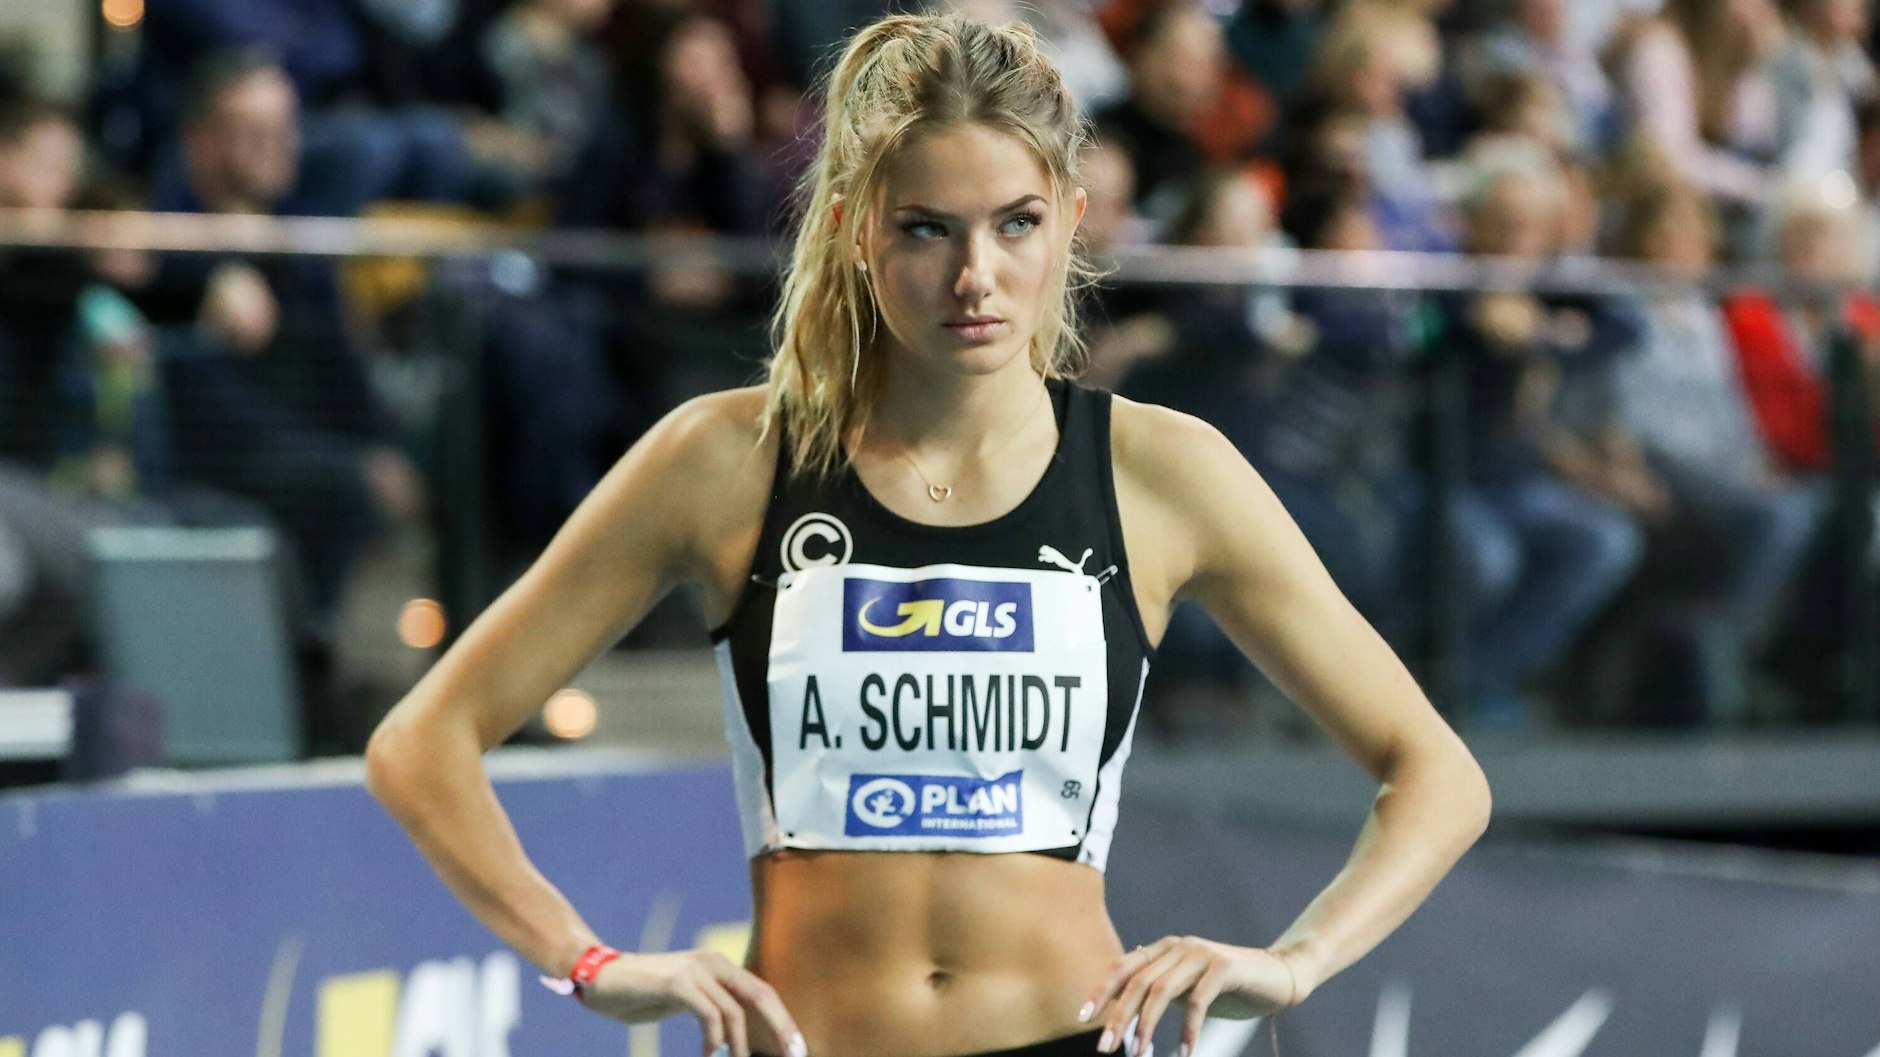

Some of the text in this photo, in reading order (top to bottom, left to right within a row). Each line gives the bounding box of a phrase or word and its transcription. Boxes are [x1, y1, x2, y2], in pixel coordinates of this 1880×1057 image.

[944, 600, 1017, 638] GLS
[800, 673, 1081, 752] A. SCHMIDT
[921, 783, 1018, 815] PLAN
[920, 817, 1018, 830] INTERNATIONAL
